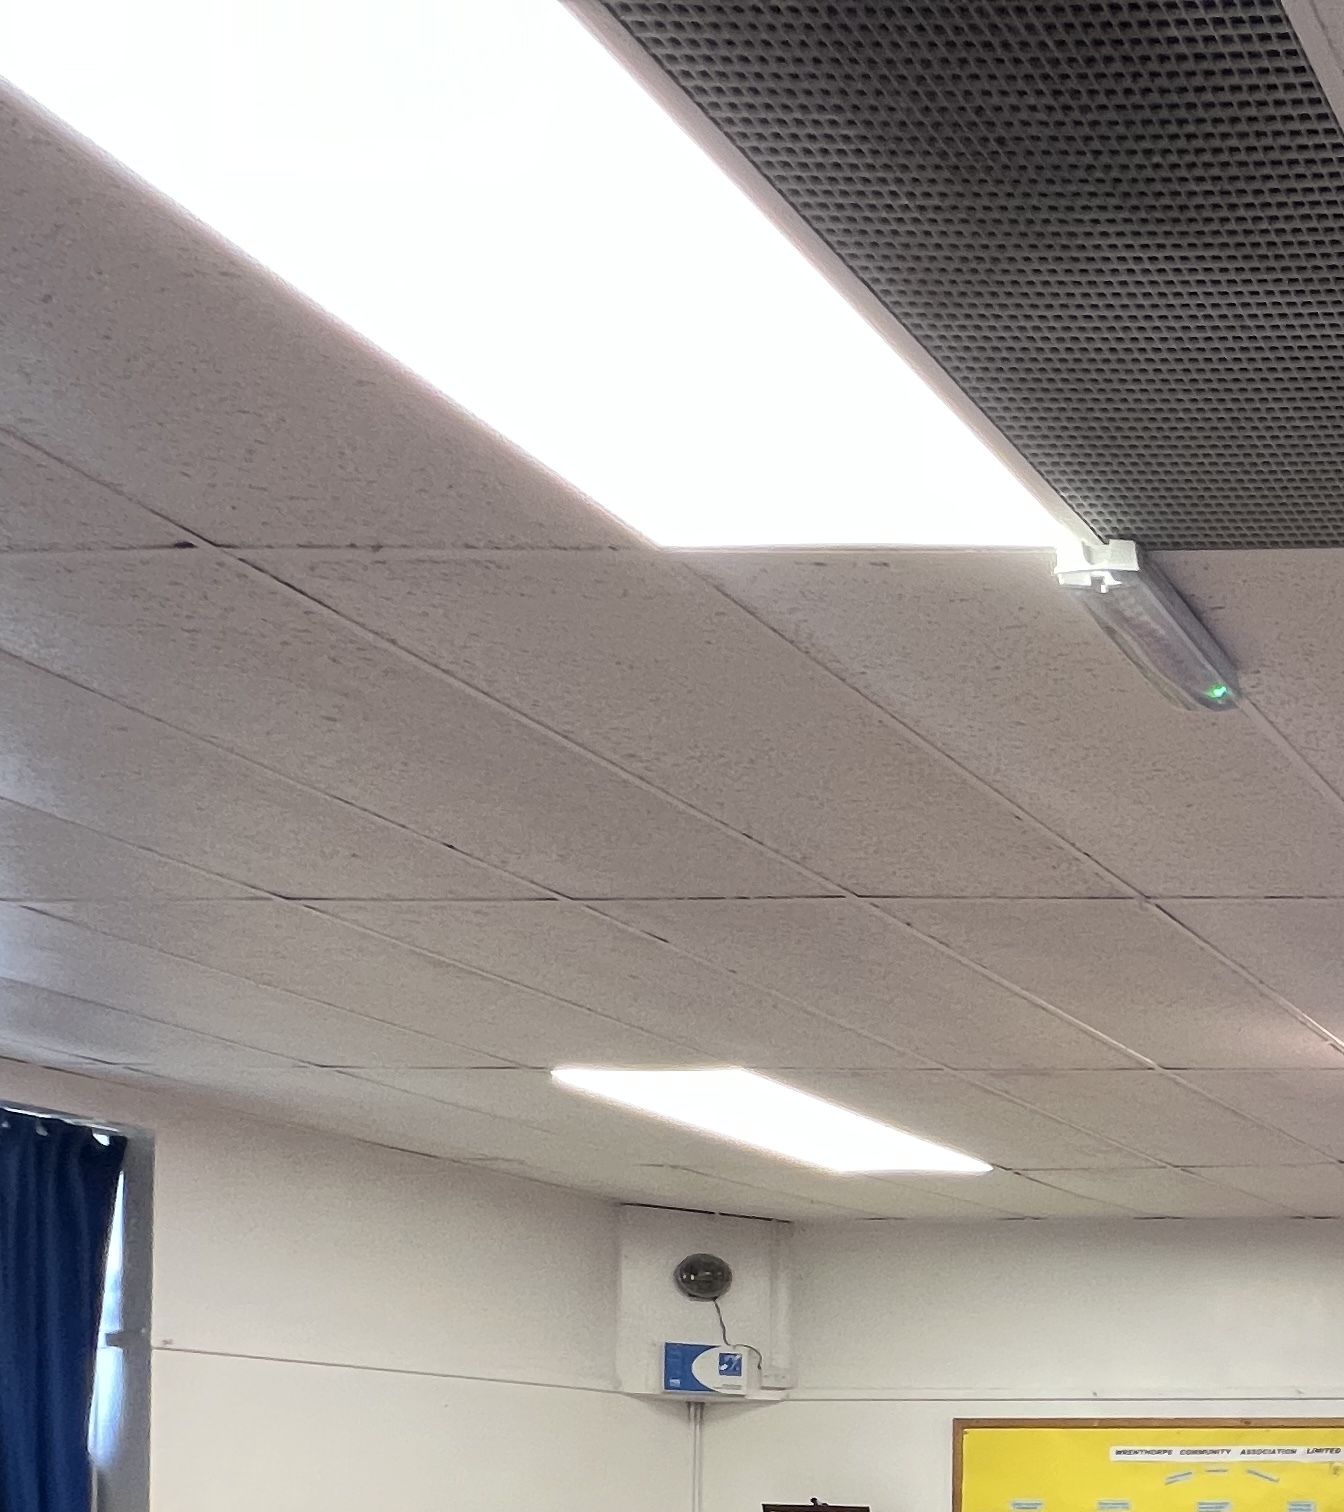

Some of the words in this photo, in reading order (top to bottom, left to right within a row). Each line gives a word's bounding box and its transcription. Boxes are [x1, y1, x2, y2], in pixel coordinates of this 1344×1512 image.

[1179, 1448, 1232, 1456] COMMUNITY
[1239, 1448, 1298, 1456] ASSOCIATION
[1305, 1447, 1342, 1455] LIMITED
